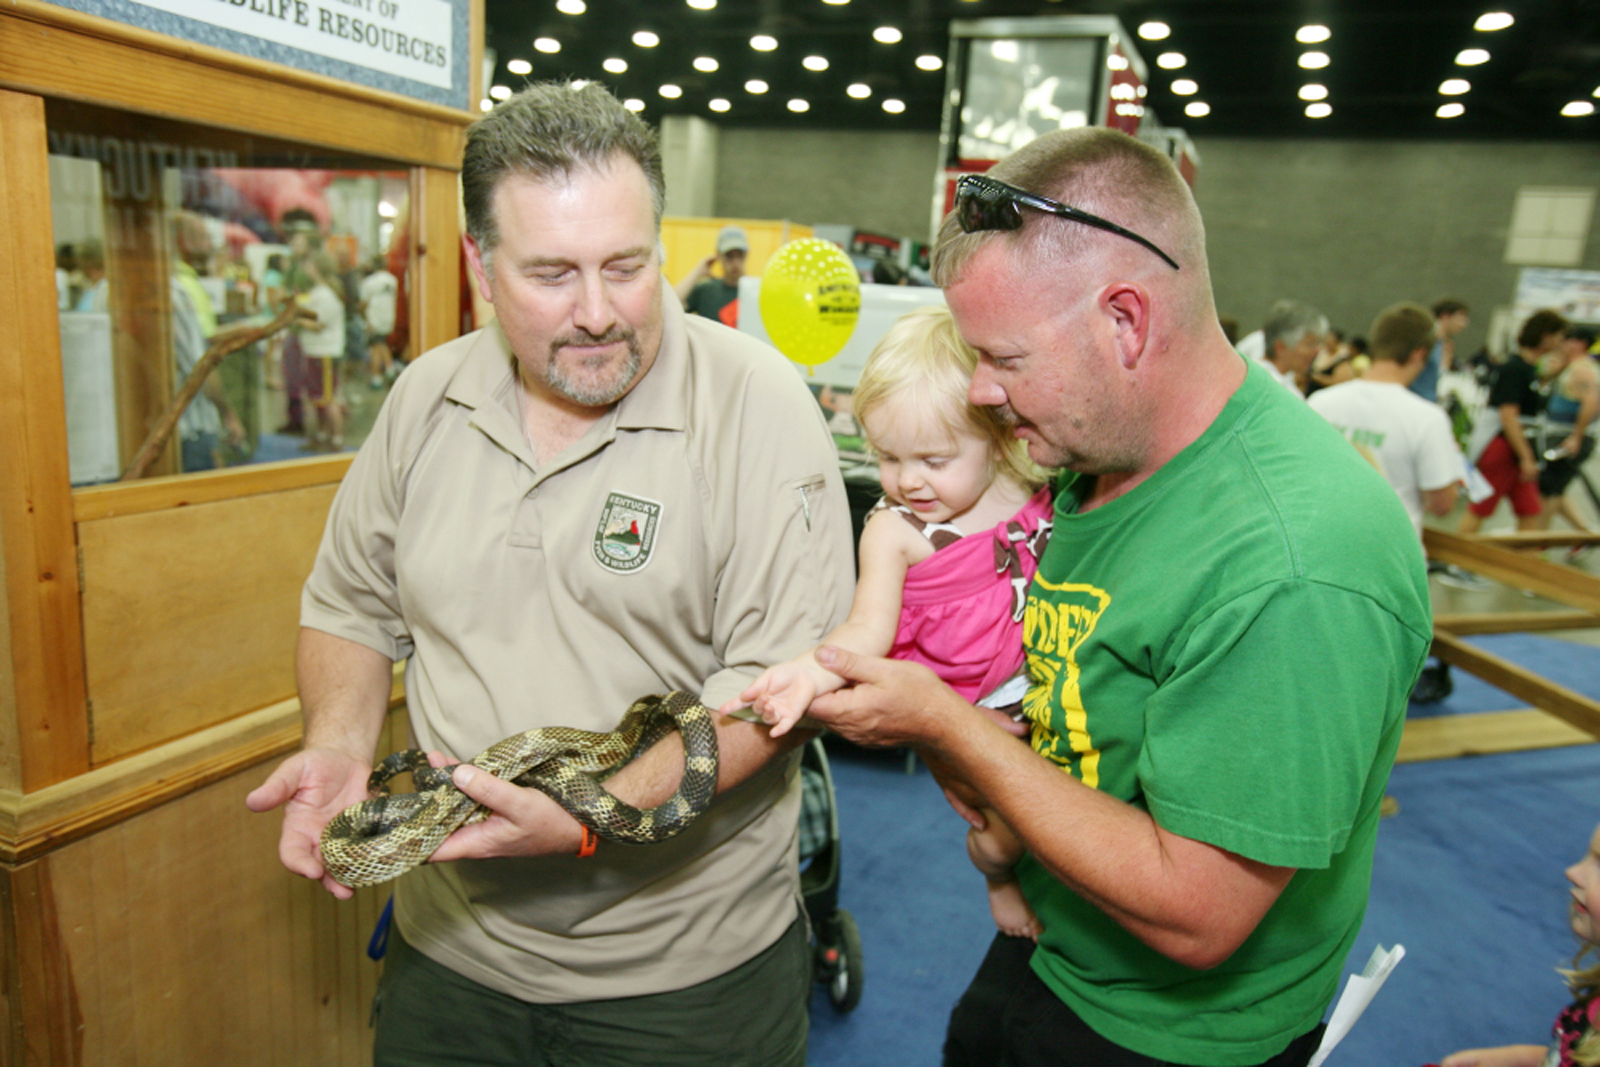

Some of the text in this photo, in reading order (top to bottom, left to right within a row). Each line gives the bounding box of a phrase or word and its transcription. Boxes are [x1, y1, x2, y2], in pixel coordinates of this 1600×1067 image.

[378, 0, 399, 20] OF
[318, 7, 447, 68] RESOURCES
[609, 495, 658, 514] KENTUCKY
